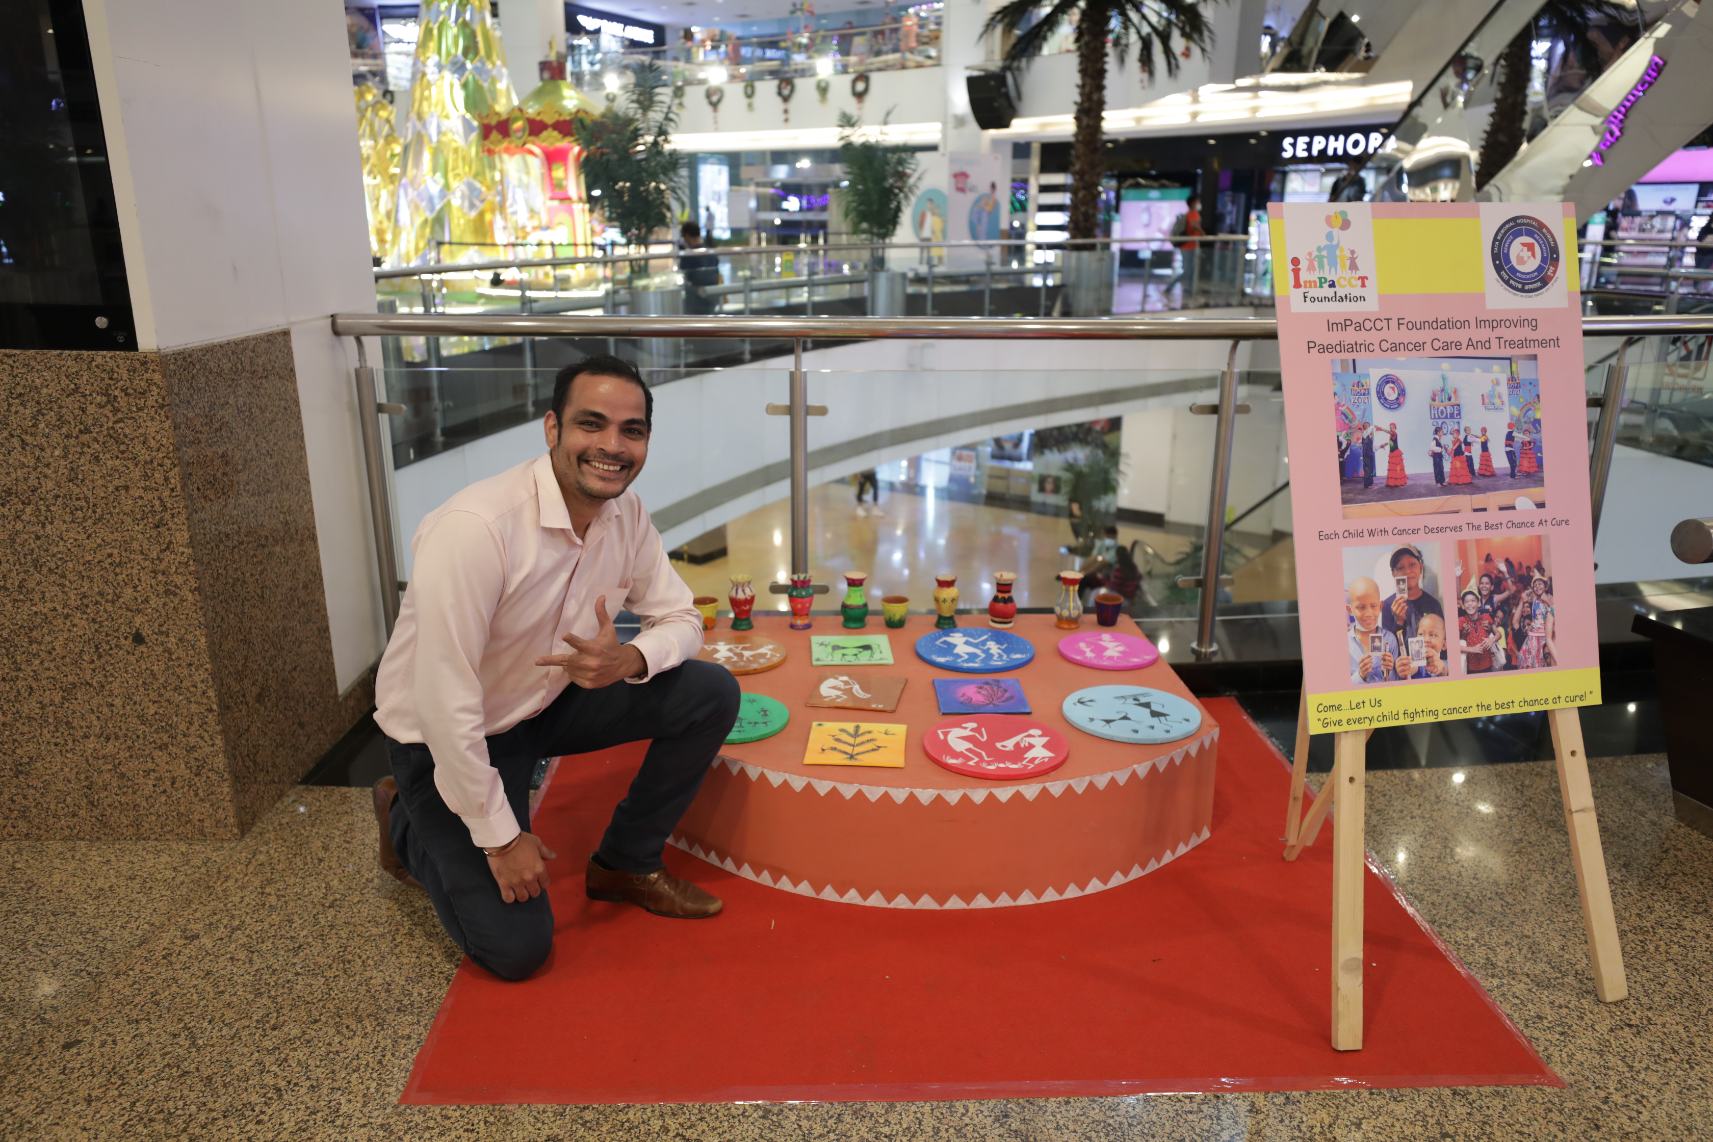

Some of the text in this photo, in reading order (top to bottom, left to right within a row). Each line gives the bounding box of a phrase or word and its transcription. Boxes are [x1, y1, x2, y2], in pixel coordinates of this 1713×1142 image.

[1503, 234, 1514, 254] SERVICE
[1534, 233, 1547, 257] RESEARCH
[1303, 290, 1367, 304] Foundation
[1327, 315, 1538, 332] ImPaCCT Foundation Improving
[1307, 336, 1561, 354] Paediatric Cancer Care And Treatment
[1431, 405, 1461, 419] HOPE
[1318, 517, 1570, 541] Each Child With Cancer Deserves The Best Chance At Cure
[1369, 697, 1382, 709] Us
[1376, 710, 1400, 723] child
[1403, 707, 1439, 722] fighting
[1441, 704, 1473, 716] cancer
[1476, 701, 1493, 713] the
[1494, 699, 1516, 711] best
[1518, 697, 1550, 708] chance
[1552, 695, 1562, 705] at
